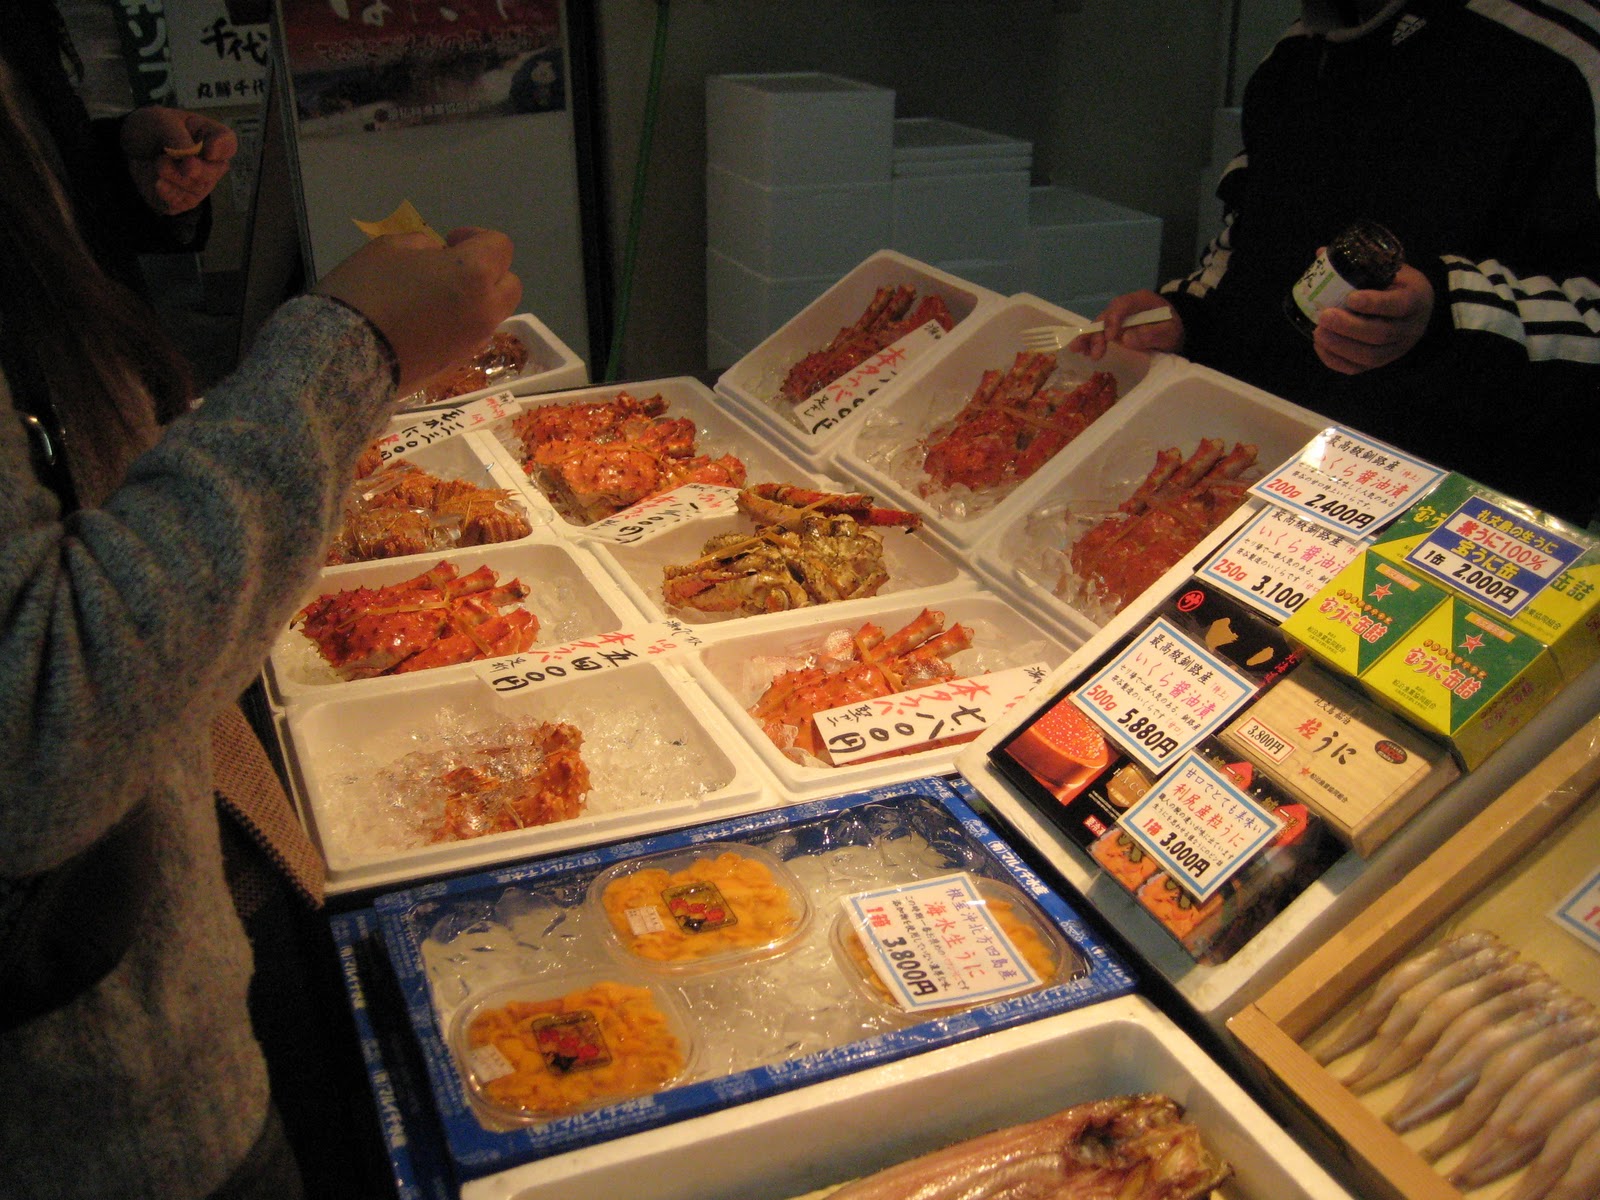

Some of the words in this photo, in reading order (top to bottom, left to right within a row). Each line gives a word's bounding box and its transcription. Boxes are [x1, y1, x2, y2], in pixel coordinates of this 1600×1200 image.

[1266, 477, 1302, 498] 200g
[1304, 493, 1376, 530] 2,400円
[1455, 519, 1550, 571] 紫うに100%
[1476, 508, 1560, 555] 礼文島の生うに
[1213, 558, 1248, 581] 250g
[1251, 574, 1310, 614] 3,100
[1422, 549, 1447, 568] 1缶
[1451, 562, 1520, 604] 2,000円
[1451, 540, 1520, 581] 宝うに缶
[1317, 596, 1391, 645] 宝うに缶詰
[1135, 651, 1216, 720] いくら醤油漬
[1149, 632, 1214, 686] 最高級釧路産
[1402, 647, 1483, 701] 宝うに缶詰
[1086, 684, 1117, 712] 500g
[1117, 708, 1179, 759] 5,880円
[1246, 724, 1285, 756] 3,800円
[1294, 718, 1357, 767] 粒うに
[1172, 783, 1245, 849] 利尻産粒うに
[1183, 768, 1263, 834] 甘口でとても美味い
[1142, 818, 1164, 836] 1箱
[1159, 831, 1211, 879] 3,000円
[865, 906, 892, 929] 1箱
[881, 936, 939, 997] 3,800円
[924, 902, 987, 979] 海水生うに
[945, 888, 1018, 980] 根室沖北方四島産
